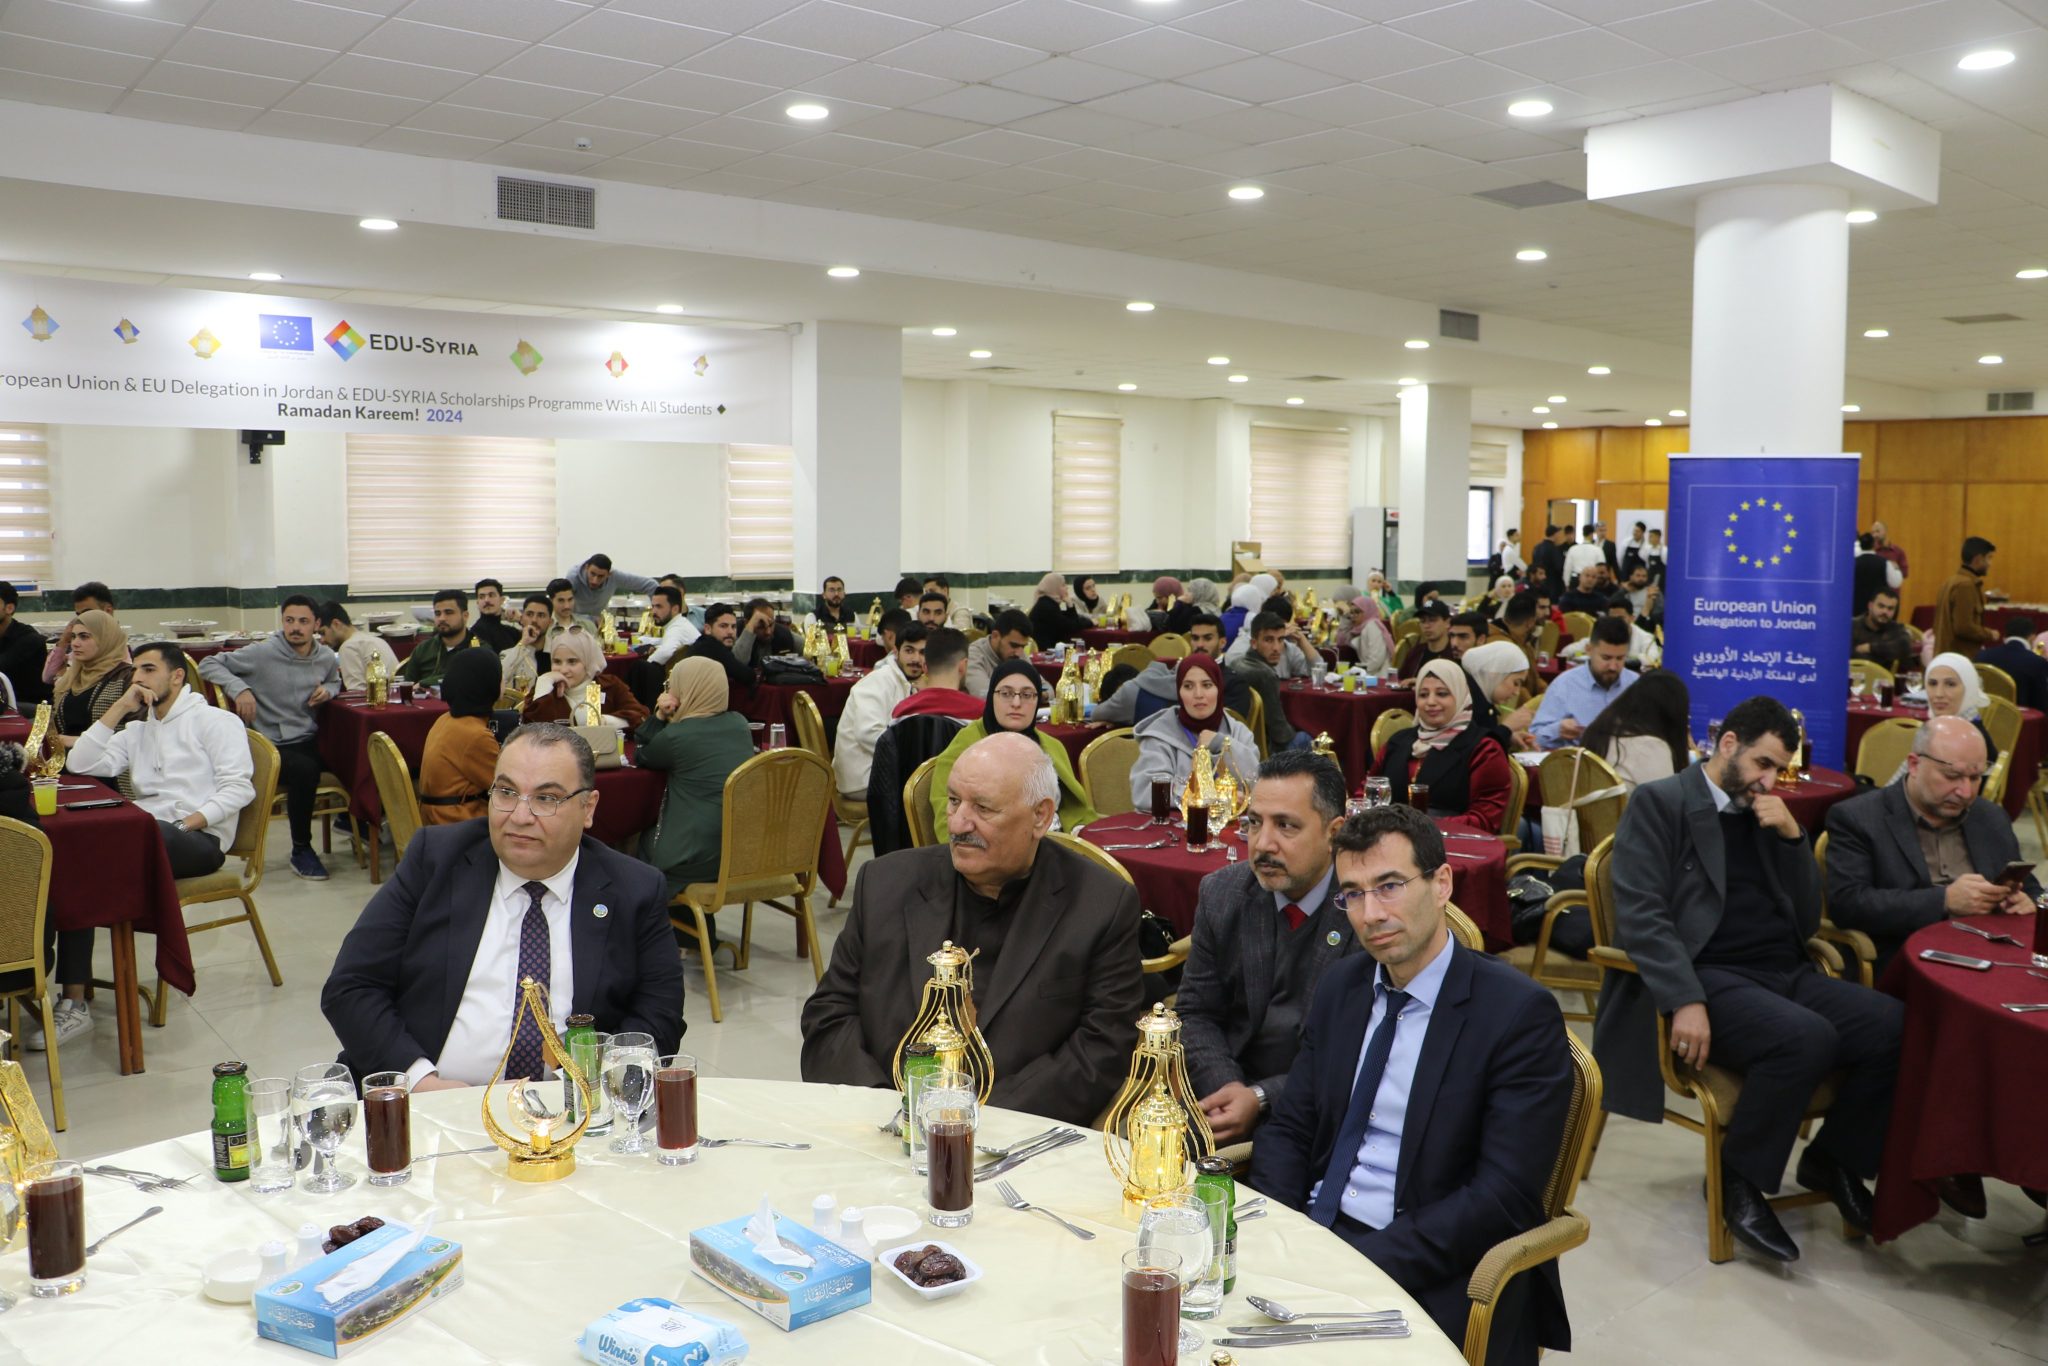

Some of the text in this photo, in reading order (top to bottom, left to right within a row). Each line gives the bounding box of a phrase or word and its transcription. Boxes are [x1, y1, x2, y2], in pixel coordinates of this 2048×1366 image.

[67, 374, 119, 391] Union
[124, 376, 137, 392] &
[142, 377, 166, 393] EU
[171, 379, 260, 399] Delegation
[264, 383, 277, 398] in
[281, 384, 333, 400] Jordan
[337, 386, 348, 401] &
[353, 387, 437, 404] EDU-SYRIA
[440, 391, 525, 410] Scholarships
[528, 395, 603, 412] Programme
[605, 399, 638, 412] Wish
[640, 400, 657, 413] All
[659, 401, 713, 415] Students
[277, 402, 463, 423] Ramadan Kareem! 2024
[1694, 597, 1816, 615] European Union
[1693, 615, 1816, 630] Delegation to Jordan
[1693, 646, 1738, 666] الأوروبي
[1730, 667, 1762, 681] الأردنية
[1798, 671, 1817, 683] لدى
[598, 1334, 638, 1365] Winnie
